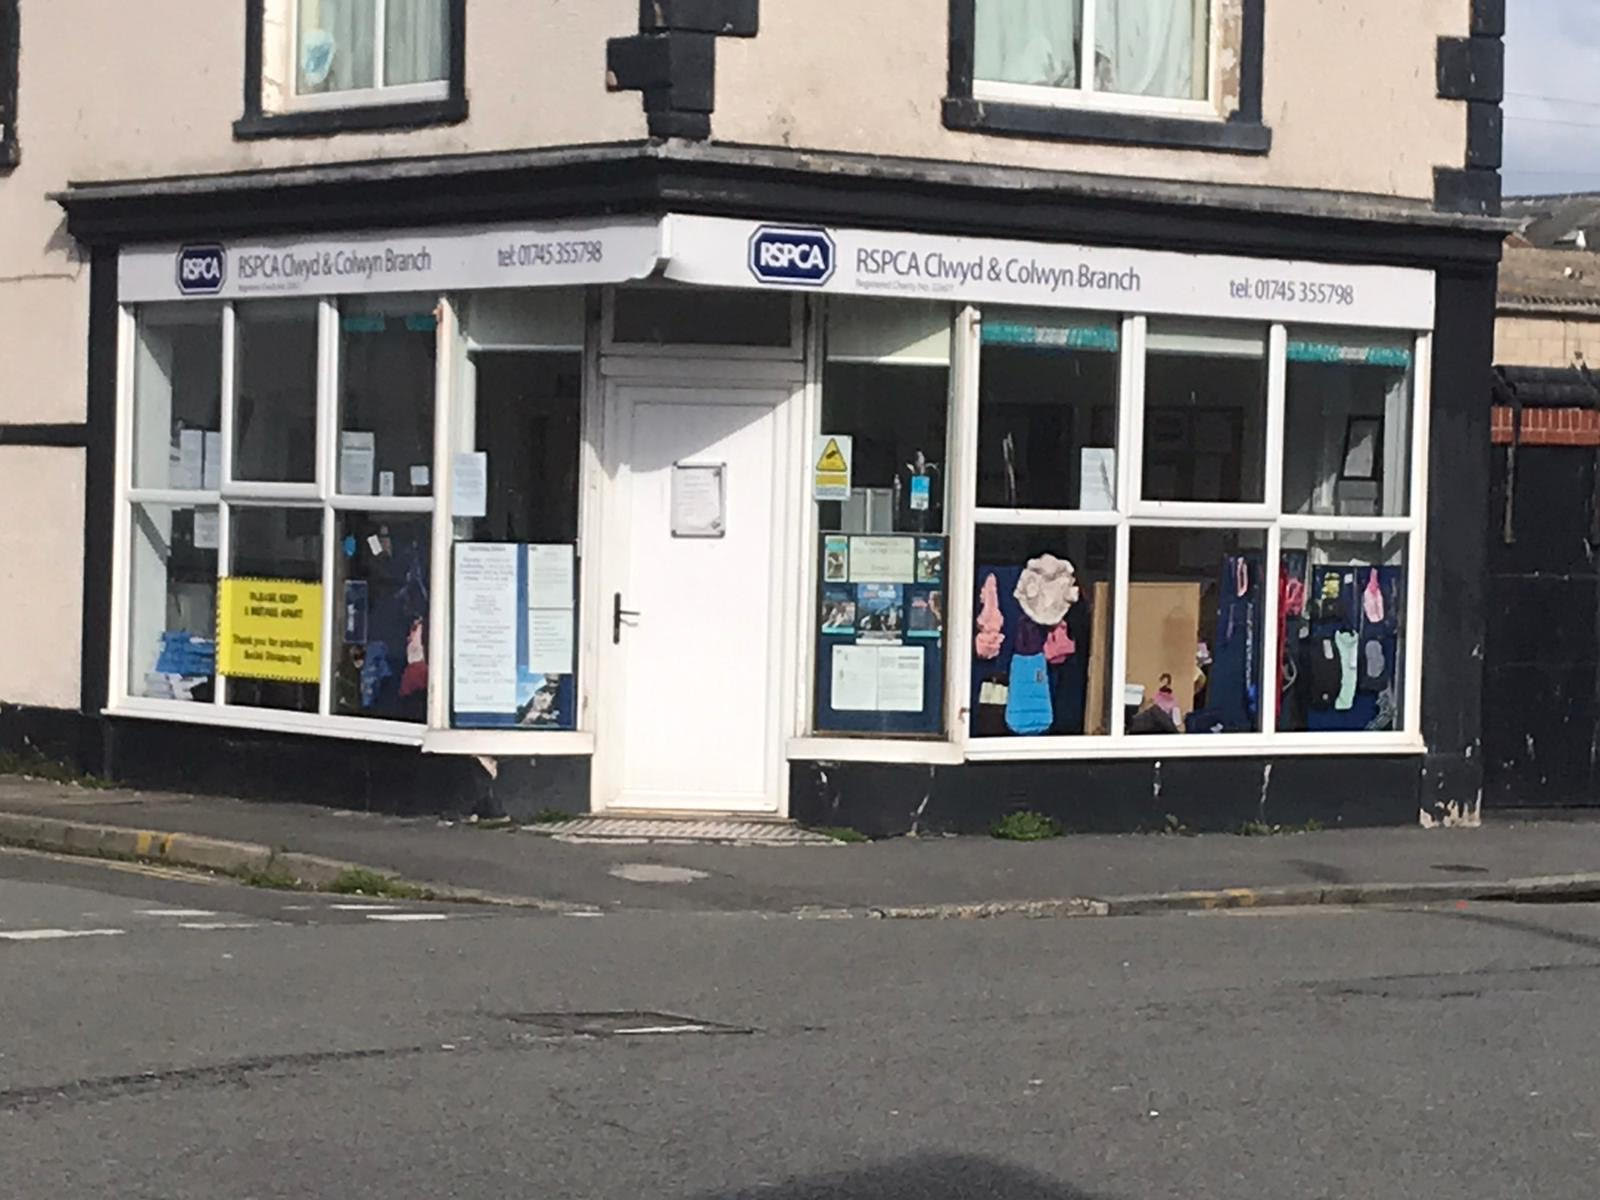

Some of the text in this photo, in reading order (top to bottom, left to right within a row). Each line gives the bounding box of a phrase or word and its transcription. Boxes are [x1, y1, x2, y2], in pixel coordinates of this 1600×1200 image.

[182, 256, 220, 279] RSPCA
[238, 246, 431, 281] RSPCA Clwyd & Colwyn Branch
[498, 241, 601, 267] tel: 01745 355798
[759, 241, 824, 270] RSPCA
[856, 248, 1140, 292] RSPCA Clwyd & Colwyn Branch
[1230, 278, 1354, 305] tel: 01745 355798
